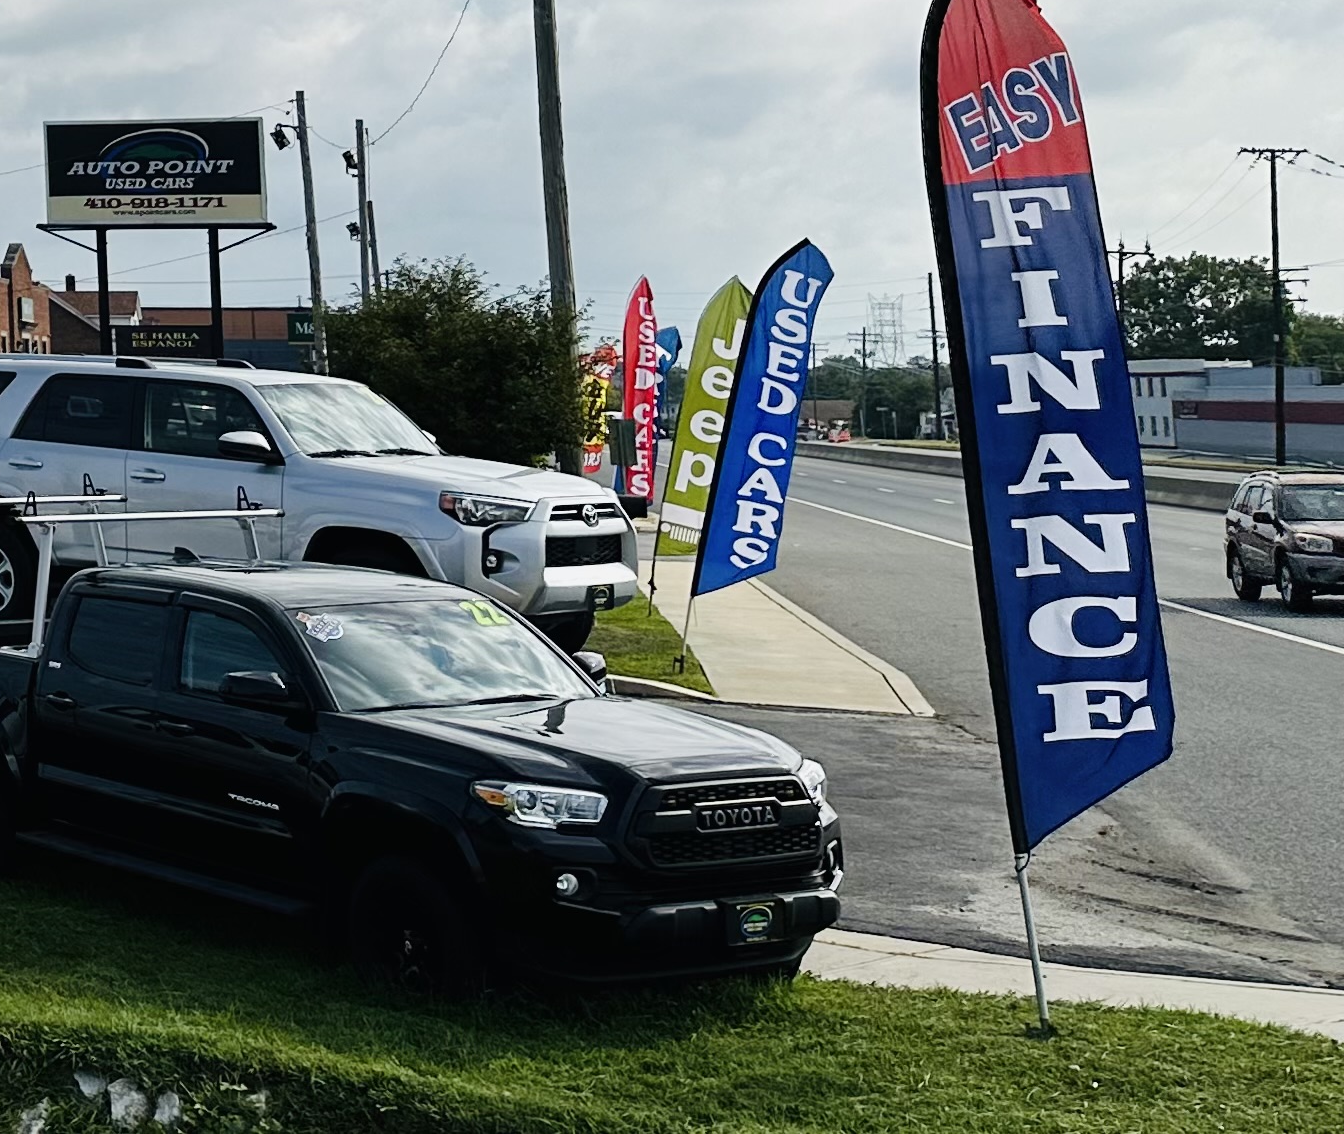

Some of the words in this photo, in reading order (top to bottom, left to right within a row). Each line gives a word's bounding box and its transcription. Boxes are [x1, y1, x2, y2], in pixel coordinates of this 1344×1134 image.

[944, 52, 1080, 174] EASY
[67, 160, 140, 175] AUTO
[146, 159, 234, 175] POINT
[84, 197, 227, 209] 410-918-1171
[105, 178, 146, 189] USED
[151, 177, 194, 189] CARS
[132, 332, 147, 340] SE
[153, 332, 199, 340] HABLA
[634, 297, 655, 390] USED
[756, 269, 823, 415] USED
[630, 403, 651, 497] CARS
[674, 318, 746, 492] Jeep
[729, 432, 788, 569] CARS
[972, 187, 1154, 743] FINANCE
[458, 601, 512, 626] 22
[700, 805, 776, 827] TOYOTA
